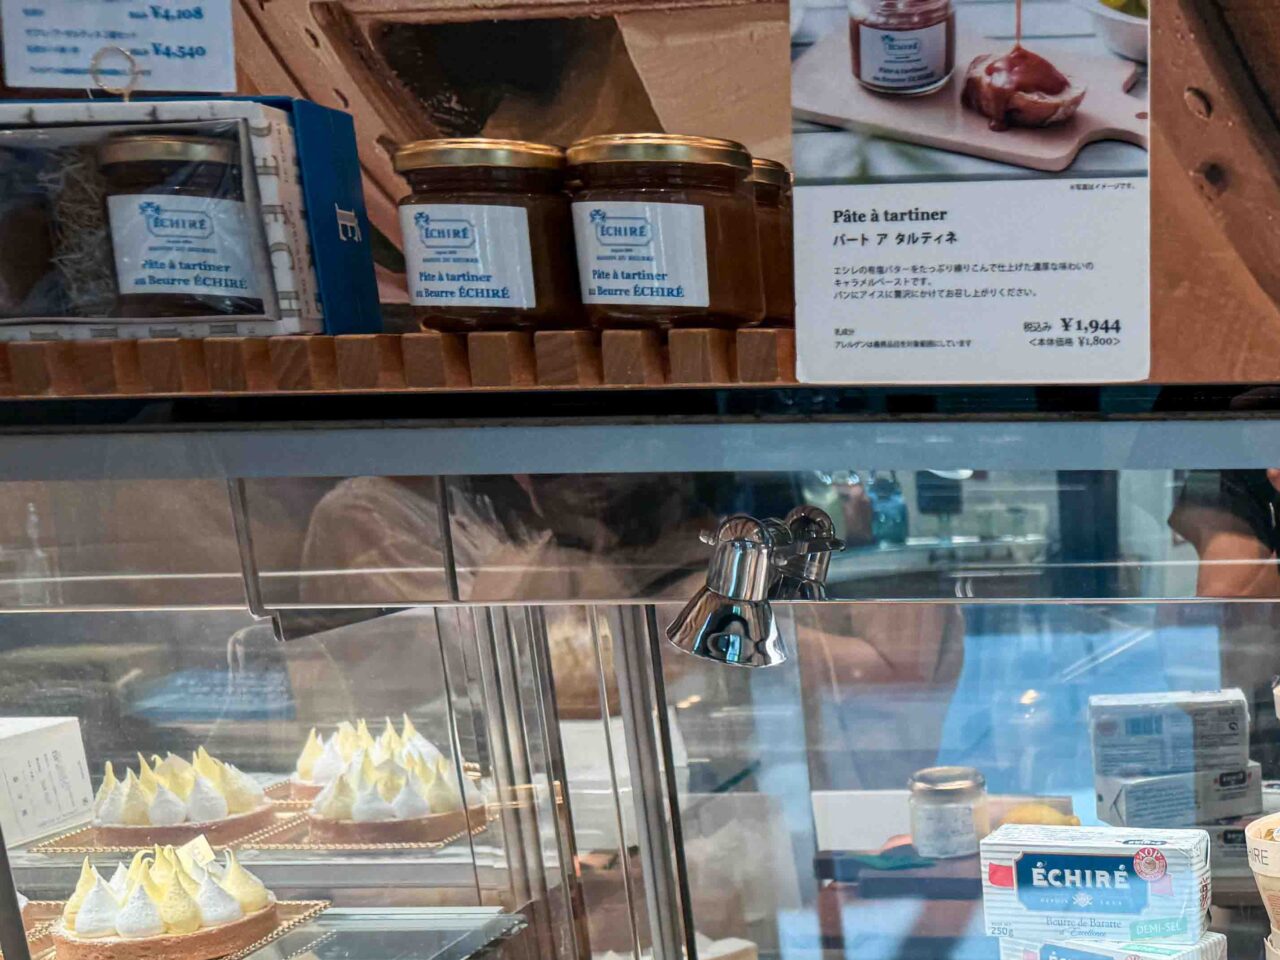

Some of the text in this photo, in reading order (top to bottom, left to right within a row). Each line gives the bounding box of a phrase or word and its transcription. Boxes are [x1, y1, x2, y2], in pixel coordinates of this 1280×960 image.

[833, 208, 947, 223] Pâte à tartiner
[153, 218, 207, 230] ÉCHIRÉ
[601, 225, 646, 236] ÉCHIRÉ
[425, 227, 469, 238] ÉCHIRÉ
[877, 233, 888, 245] ア
[895, 231, 957, 245] タルティネ
[1023, 318, 1121, 333] 税込み ¥1,944
[1032, 860, 1131, 889] ÉCHIRÉ
[991, 927, 1014, 937] 250g
[1136, 919, 1182, 935] DEMI-SEL
